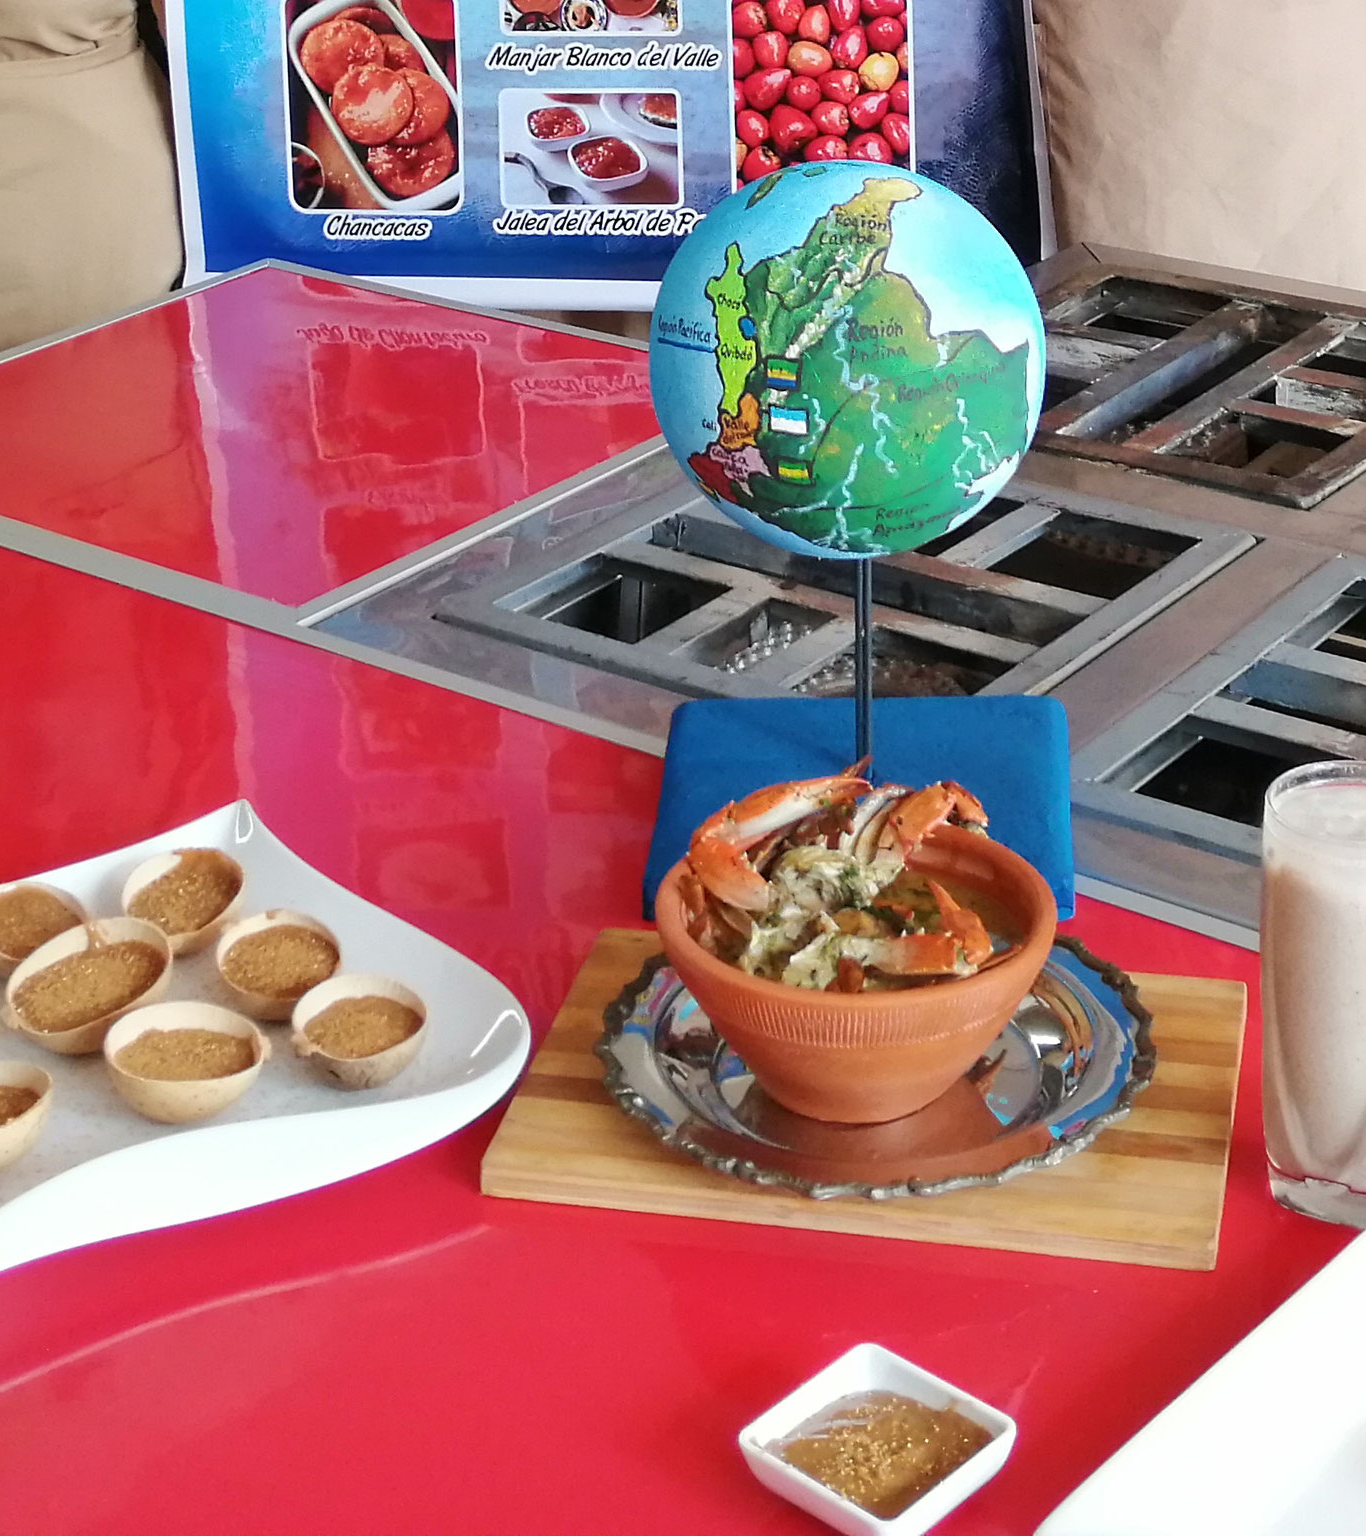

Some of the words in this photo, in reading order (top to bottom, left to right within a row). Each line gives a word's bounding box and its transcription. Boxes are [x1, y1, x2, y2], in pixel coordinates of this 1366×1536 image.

[489, 46, 560, 72] Manjar
[566, 44, 632, 68] Blanco
[637, 43, 666, 66] del
[671, 44, 720, 67] Valle
[326, 214, 429, 237] Chancacas
[496, 212, 548, 233] Jalea
[553, 210, 584, 232] del
[588, 210, 643, 233] Arbol
[646, 211, 670, 233] de
[846, 317, 904, 345] Región
[701, 417, 718, 433] Cali
